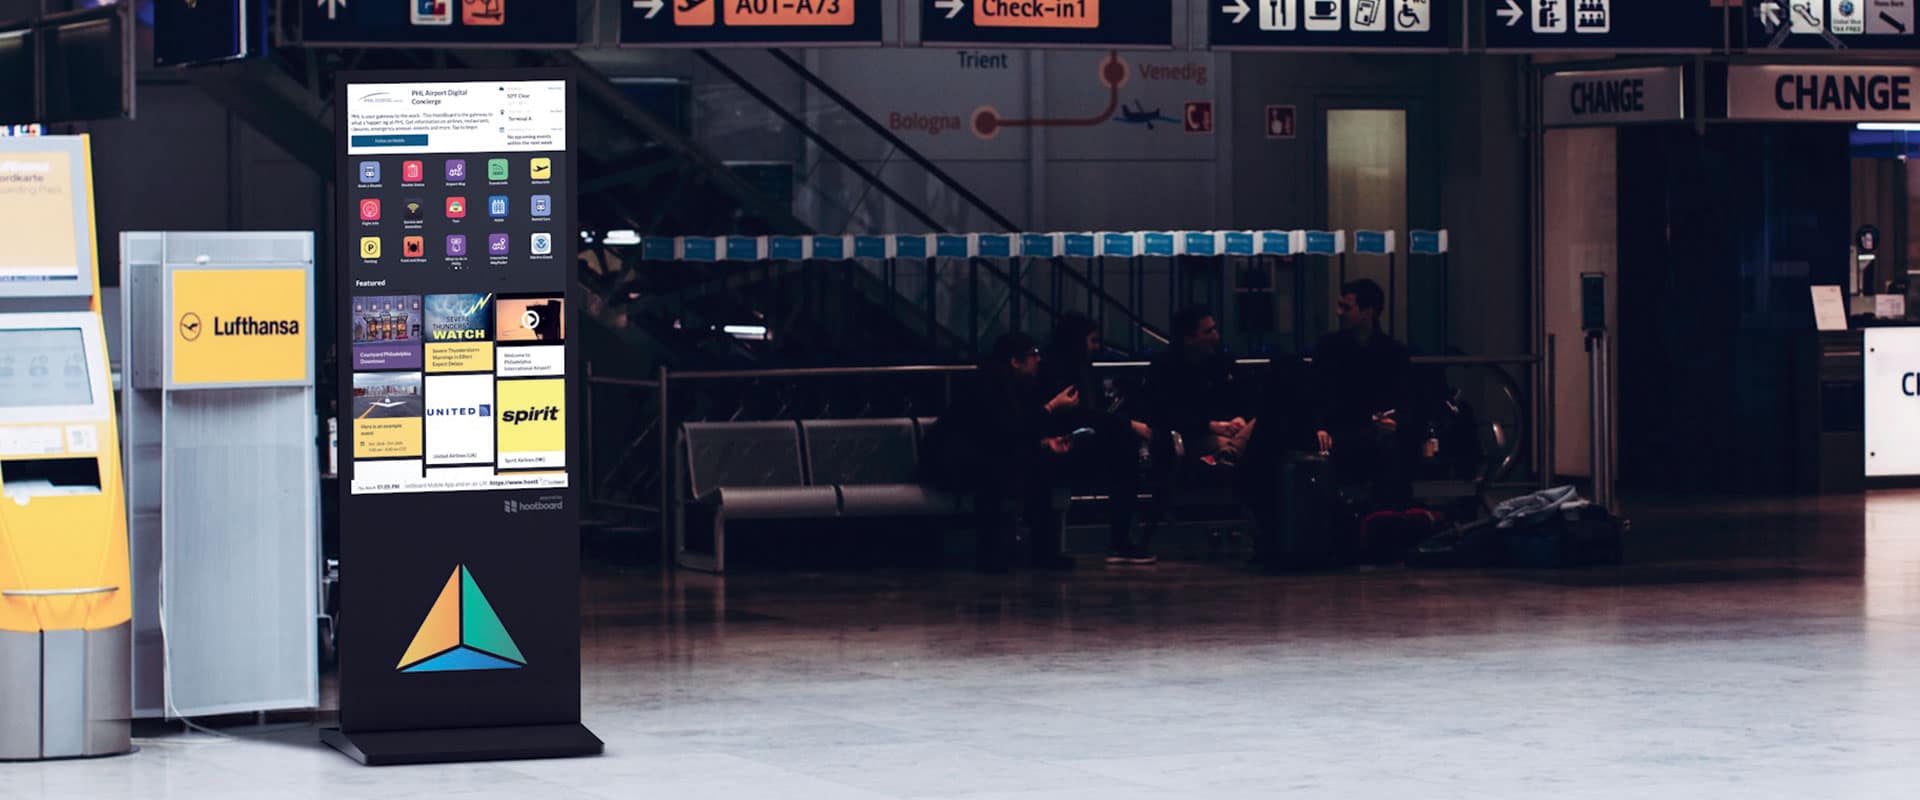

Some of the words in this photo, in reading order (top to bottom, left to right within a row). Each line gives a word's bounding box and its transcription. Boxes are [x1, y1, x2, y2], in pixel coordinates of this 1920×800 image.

[957, 50, 1008, 69] Trient
[1138, 63, 1208, 84] Venedig
[447, 89, 468, 97] Digital
[1570, 79, 1644, 115] CHANGE
[1775, 74, 1911, 110] CHANGE
[889, 112, 961, 134] Bologna
[214, 316, 299, 336] Lufthansa
[433, 329, 485, 340] WATCH
[1902, 372, 1920, 396] C
[427, 408, 476, 416] UNITED
[502, 406, 560, 425] spirit
[519, 501, 563, 510] hootboard
